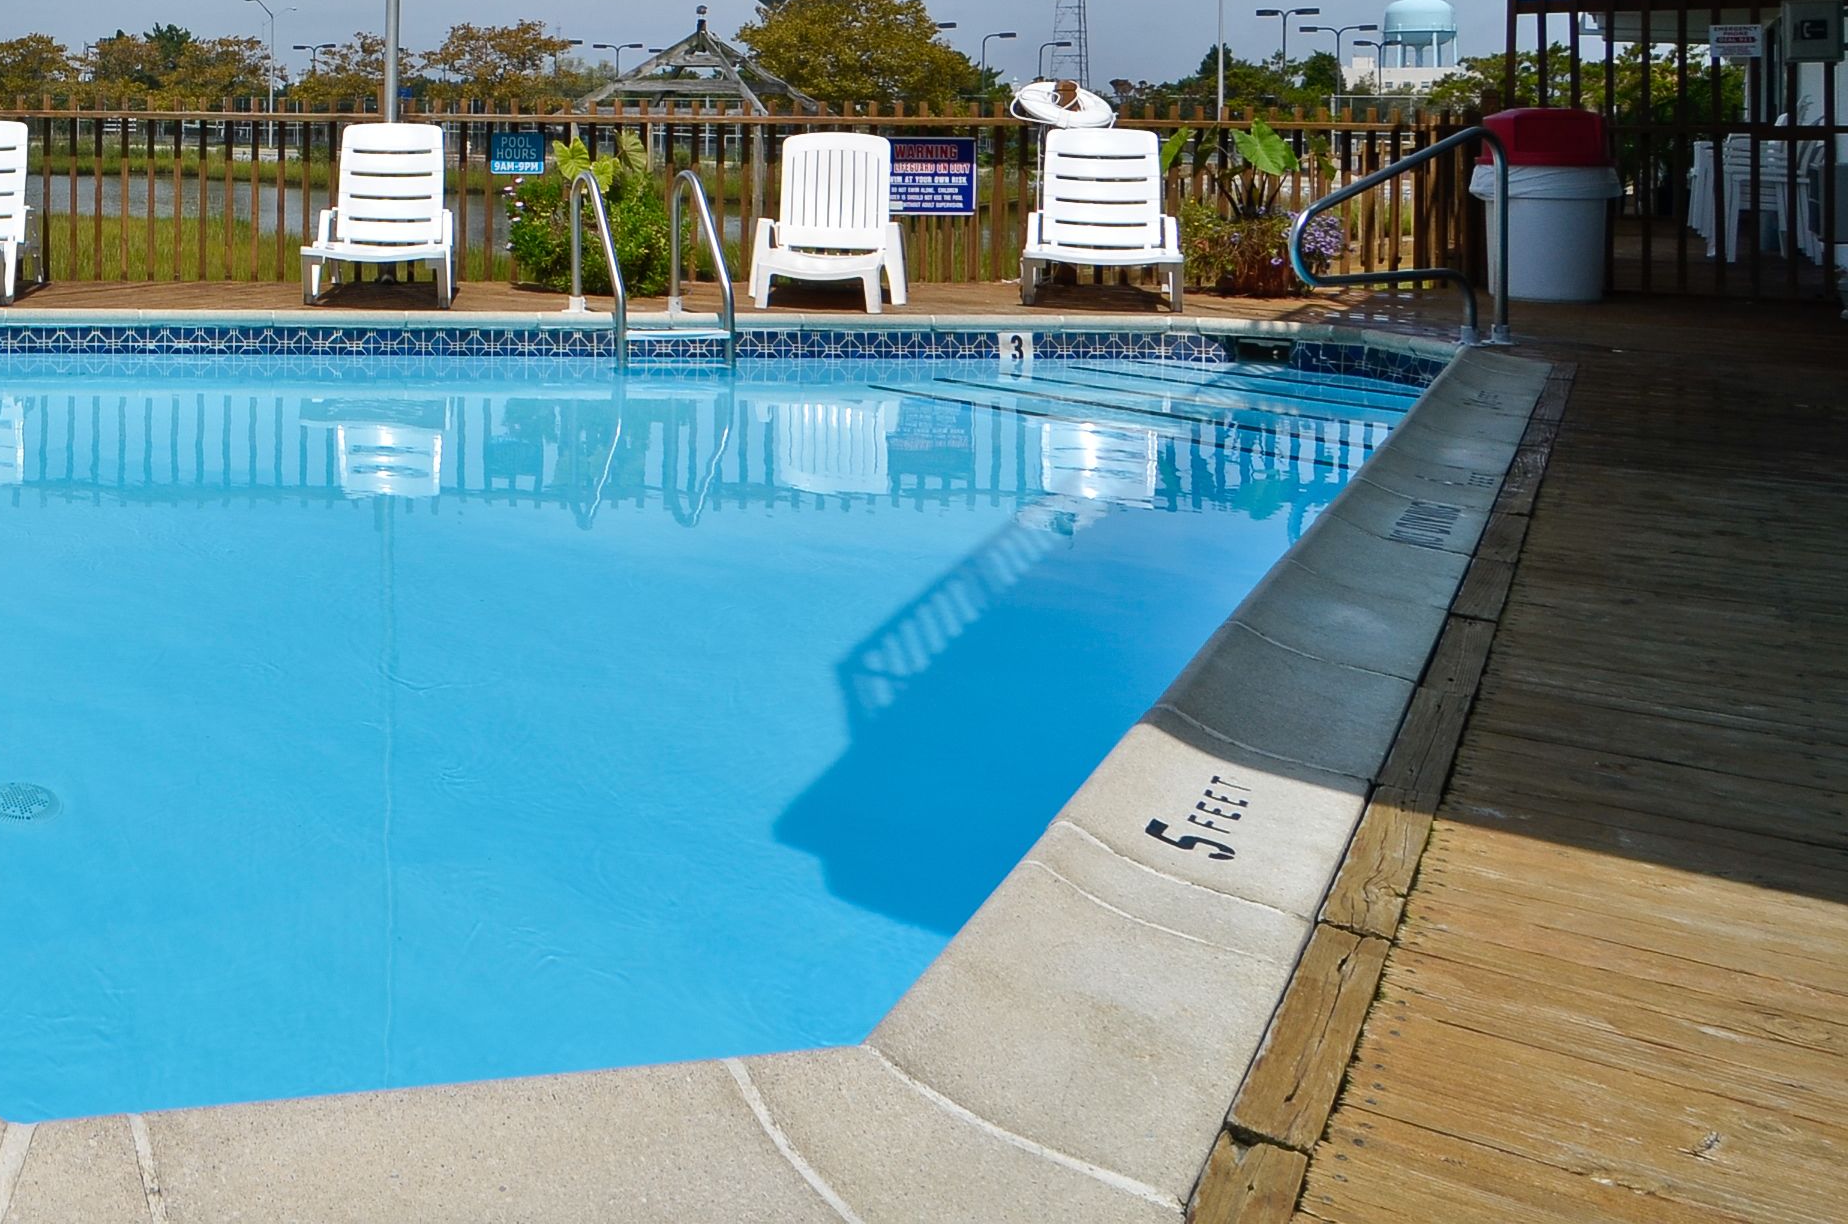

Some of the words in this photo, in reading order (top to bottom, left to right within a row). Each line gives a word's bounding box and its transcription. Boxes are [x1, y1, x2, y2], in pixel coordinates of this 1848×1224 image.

[501, 136, 532, 148] POOL
[496, 148, 537, 160] HOURS
[894, 144, 958, 160] WARNING
[494, 161, 539, 171] 9AM-9PM
[893, 162, 935, 173] LIFEGUARD
[937, 163, 948, 173] ON
[950, 163, 970, 174] DUTY
[952, 176, 967, 184] RISK
[1011, 335, 1024, 360] 3
[1186, 774, 1252, 834] FEET
[1144, 817, 1237, 861] 5
